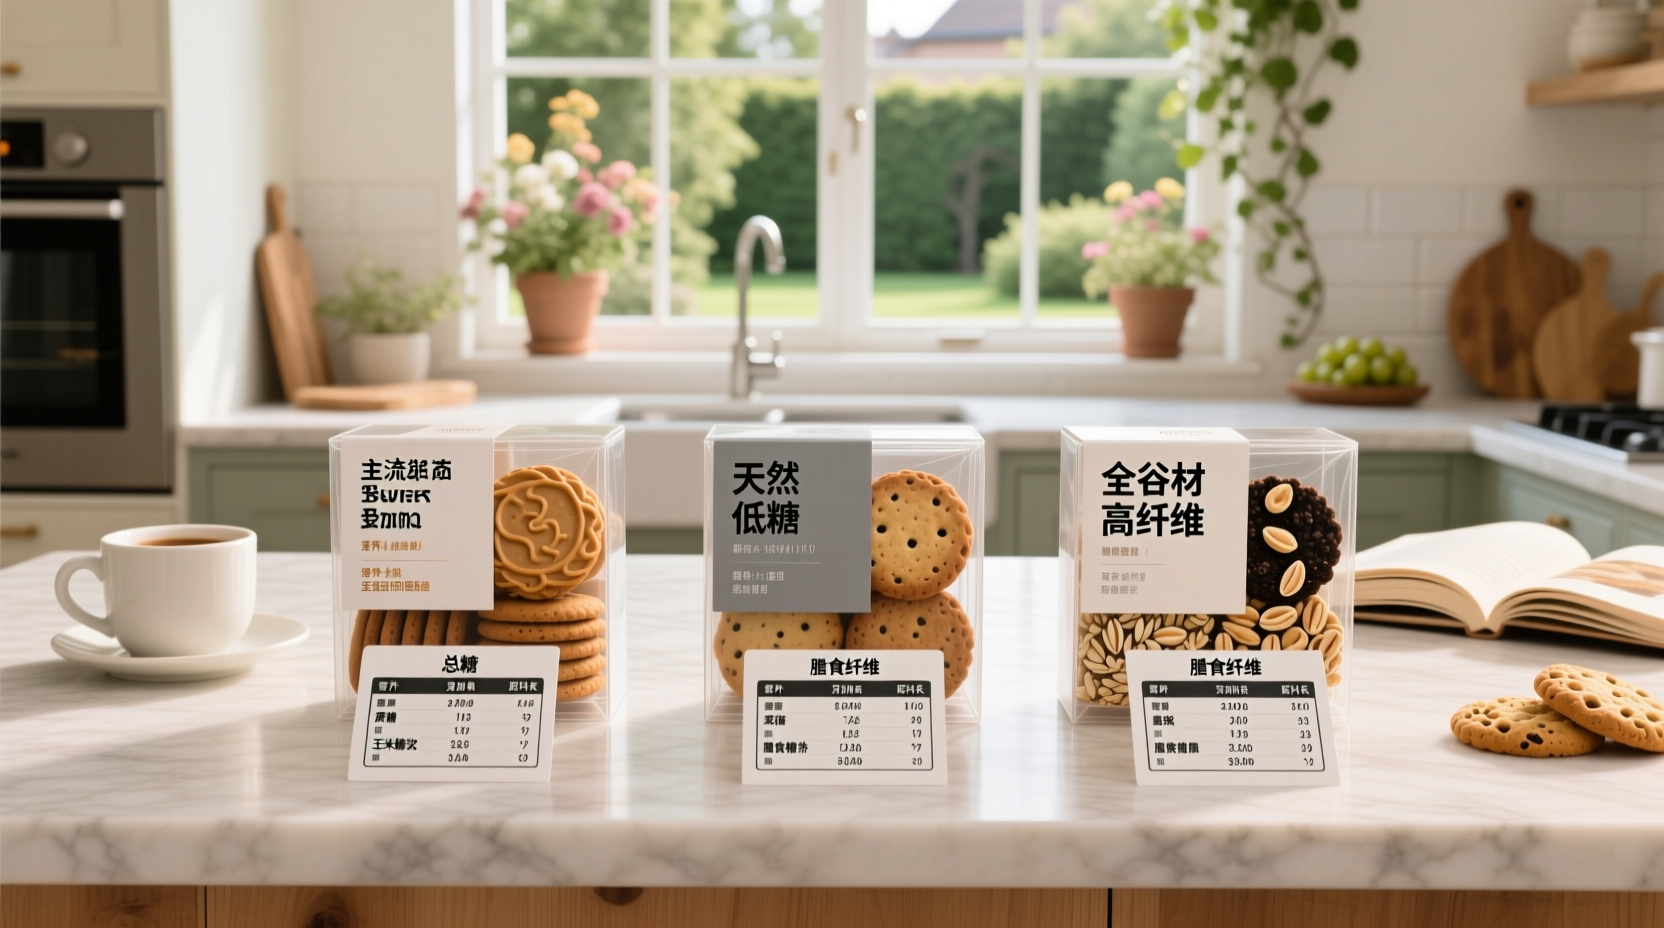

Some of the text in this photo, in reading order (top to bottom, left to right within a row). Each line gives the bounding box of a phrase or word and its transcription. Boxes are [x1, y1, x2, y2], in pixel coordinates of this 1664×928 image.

[733, 461, 799, 495] 天然
[1102, 461, 1205, 496] 全谷材
[732, 501, 799, 535] 低糖
[1102, 502, 1205, 537] 高纤维
